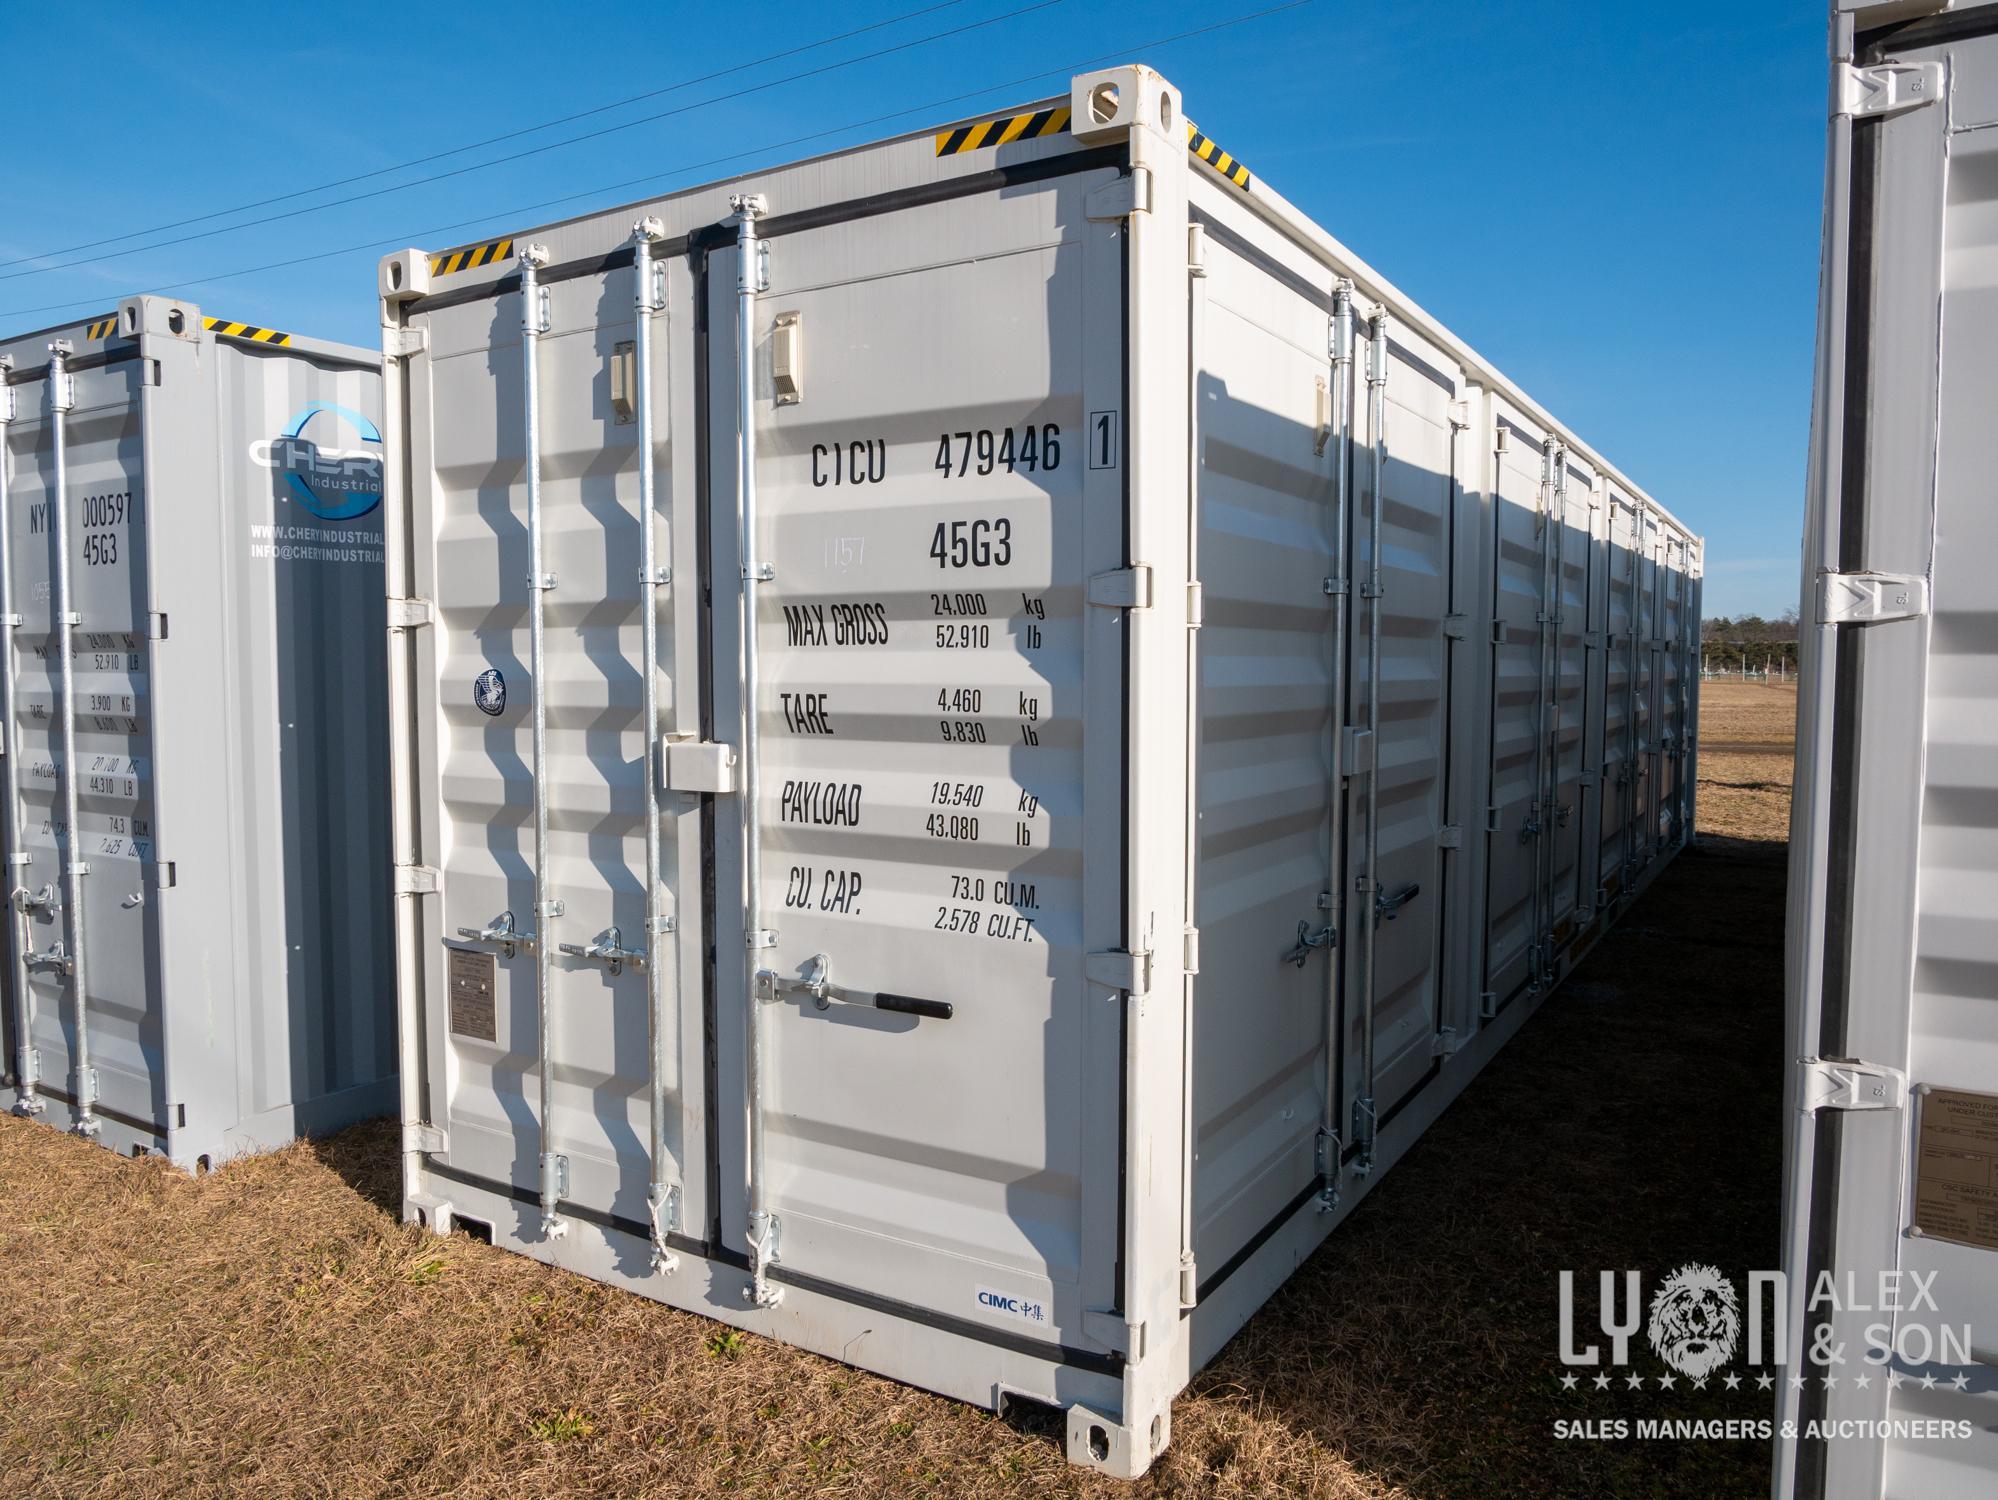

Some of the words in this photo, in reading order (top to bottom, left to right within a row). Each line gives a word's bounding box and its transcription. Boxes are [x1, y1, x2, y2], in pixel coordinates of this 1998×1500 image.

[812, 439, 886, 487] CICU
[934, 423, 1061, 478] 479446
[1097, 415, 1110, 465] 1
[311, 474, 382, 492] Industrial
[82, 492, 132, 528] 000597
[83, 532, 117, 566] 45G3
[930, 518, 1012, 569] 45G3
[1022, 592, 1045, 620] kg
[783, 604, 828, 646] MAX
[831, 603, 888, 645] GROSS
[936, 625, 989, 648] 52,910
[1027, 625, 1041, 649] lb
[130, 654, 139, 670] LB
[121, 696, 130, 712] KG
[780, 694, 834, 734] TARE
[938, 688, 981, 713] 4,460
[1020, 691, 1038, 721] kg
[1021, 724, 1039, 746] lb
[32, 762, 60, 779] PAYLOAD
[124, 780, 133, 796] LB
[782, 780, 862, 826] PAYLOAD
[931, 782, 984, 808] 19,540
[1018, 788, 1039, 818] kg
[109, 816, 125, 834] 74.3
[926, 814, 978, 840] 43,080
[1016, 822, 1030, 846] lb
[786, 866, 812, 910] CU.
[820, 870, 862, 915] CAP.
[952, 876, 984, 902] 73.0
[994, 881, 1040, 910] CU.M.
[934, 906, 980, 934] 2,578
[987, 914, 1034, 942] CU.FT.
[978, 1292, 1018, 1312] CIMC
[1020, 1301, 1044, 1320] 中集
